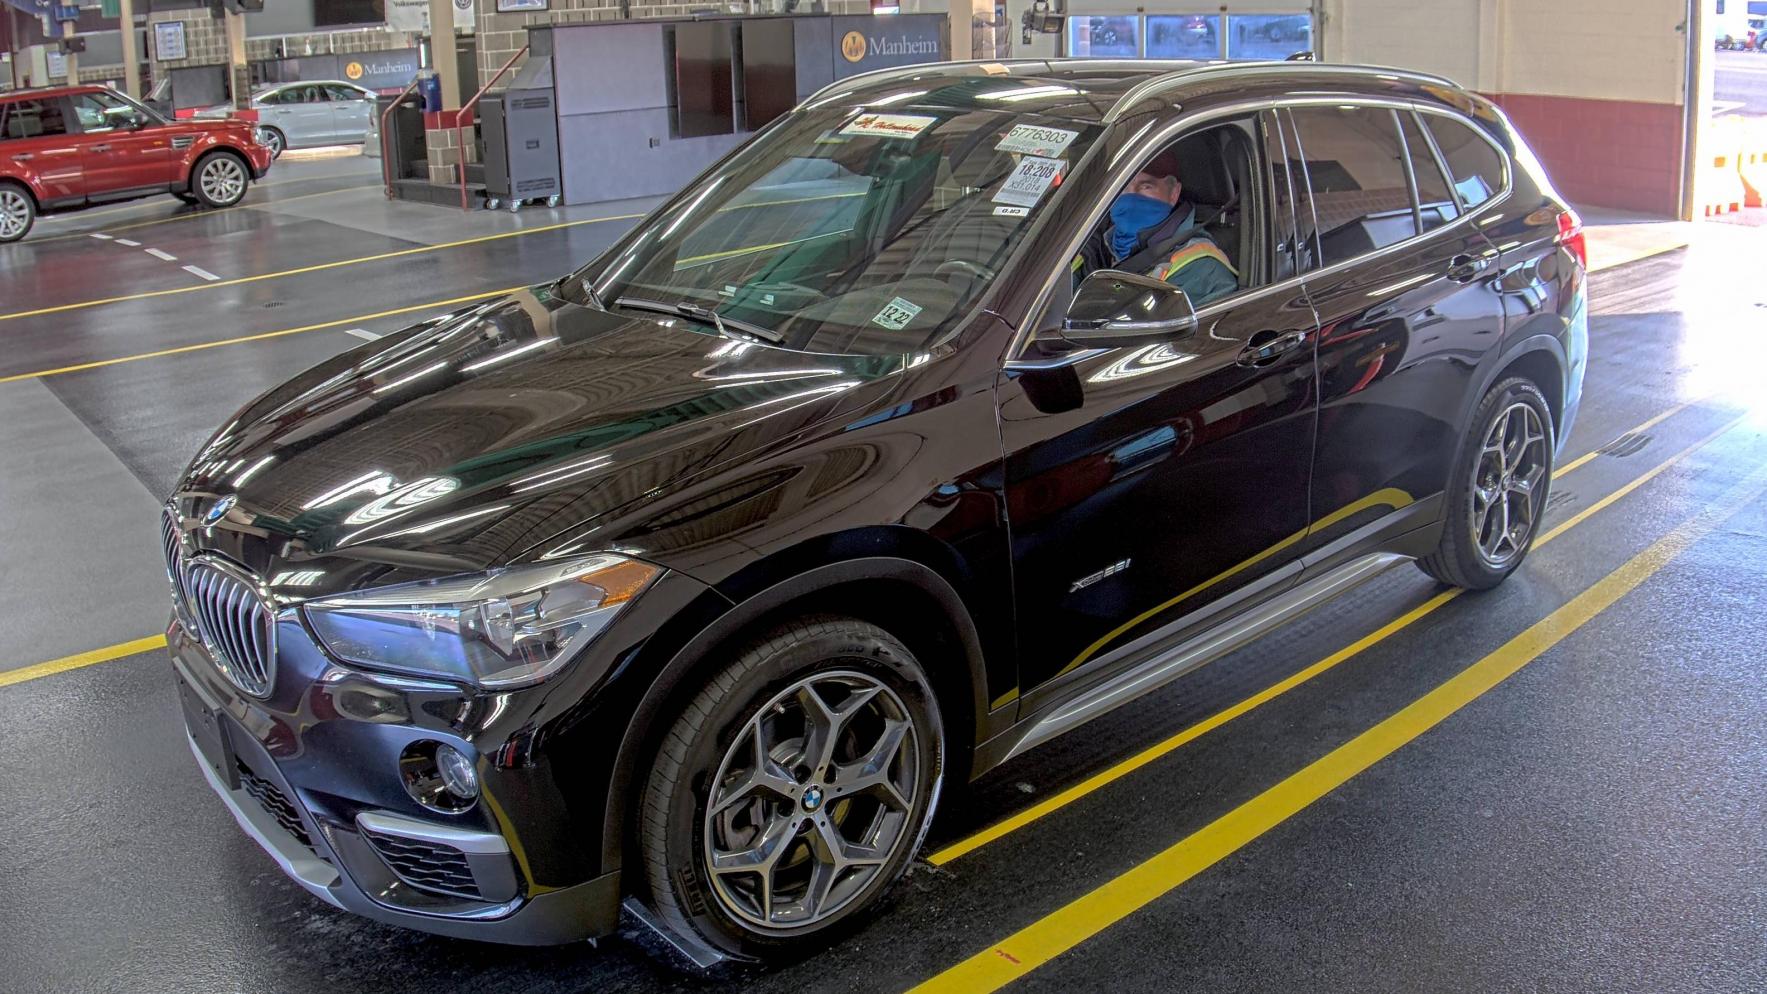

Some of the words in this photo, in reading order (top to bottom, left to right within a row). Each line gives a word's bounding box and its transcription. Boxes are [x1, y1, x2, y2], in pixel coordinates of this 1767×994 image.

[868, 35, 938, 55] Manheim
[364, 61, 411, 75] Manheim
[1009, 127, 1068, 144] 6776303
